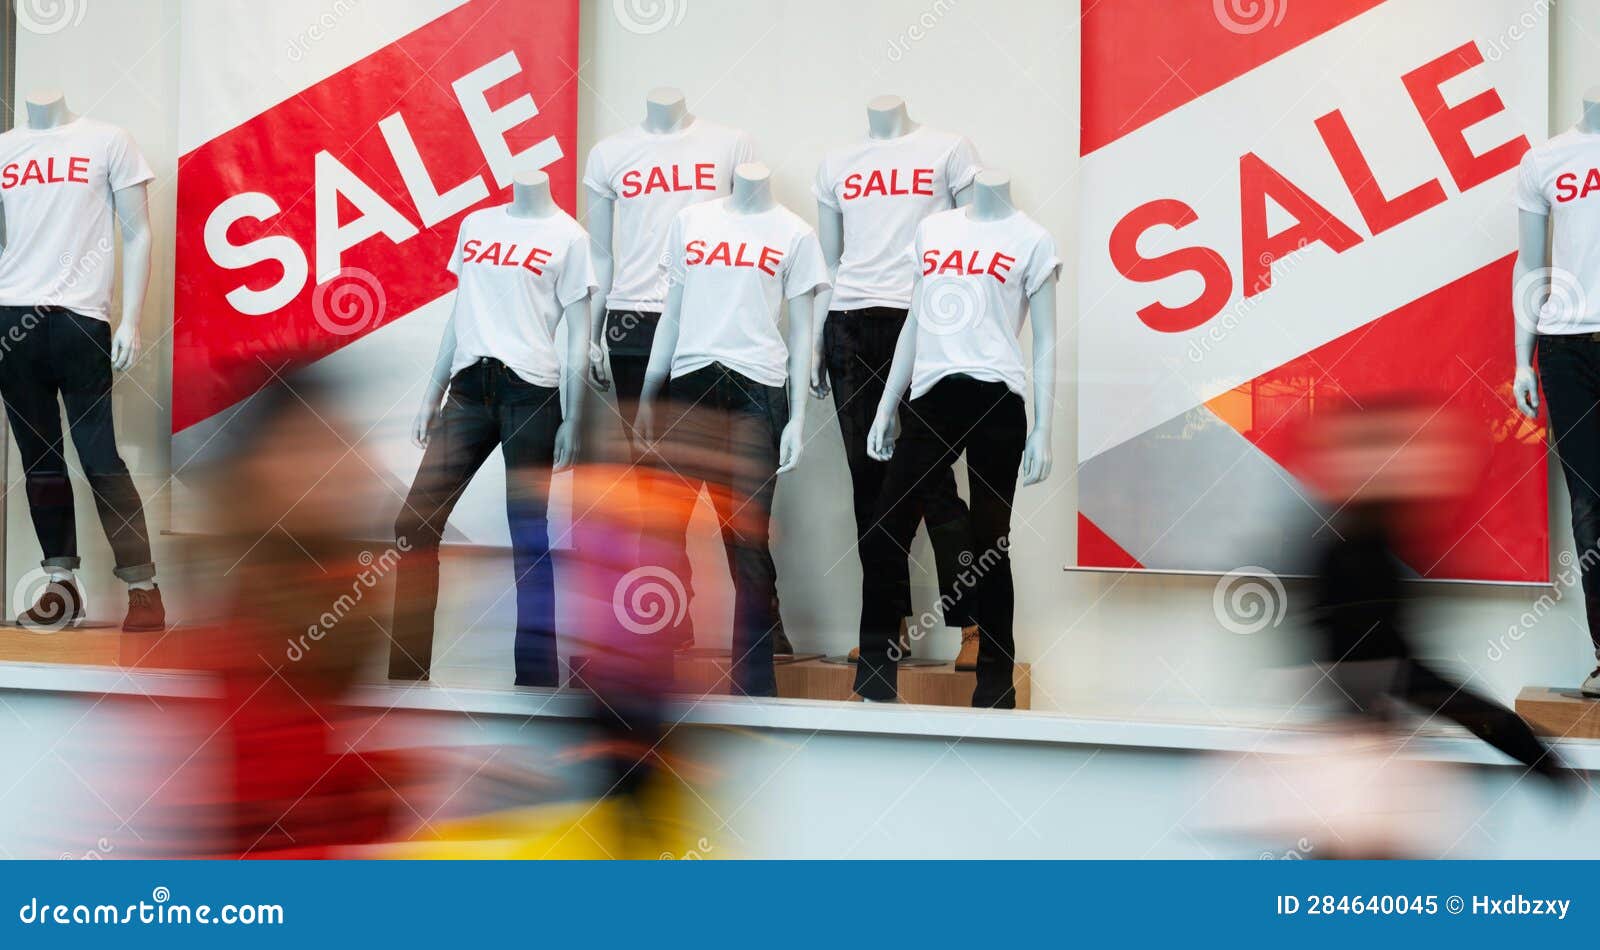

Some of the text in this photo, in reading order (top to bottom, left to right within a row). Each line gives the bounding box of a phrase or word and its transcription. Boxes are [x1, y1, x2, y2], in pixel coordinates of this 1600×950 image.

[2, 157, 90, 189] SALE
[204, 50, 564, 315] SALE
[622, 163, 716, 198] SALE
[843, 168, 934, 200] SALE
[1108, 40, 1531, 333] SALE
[462, 240, 552, 276] SALE
[686, 240, 784, 277] SALE
[923, 249, 1016, 284] SALE
